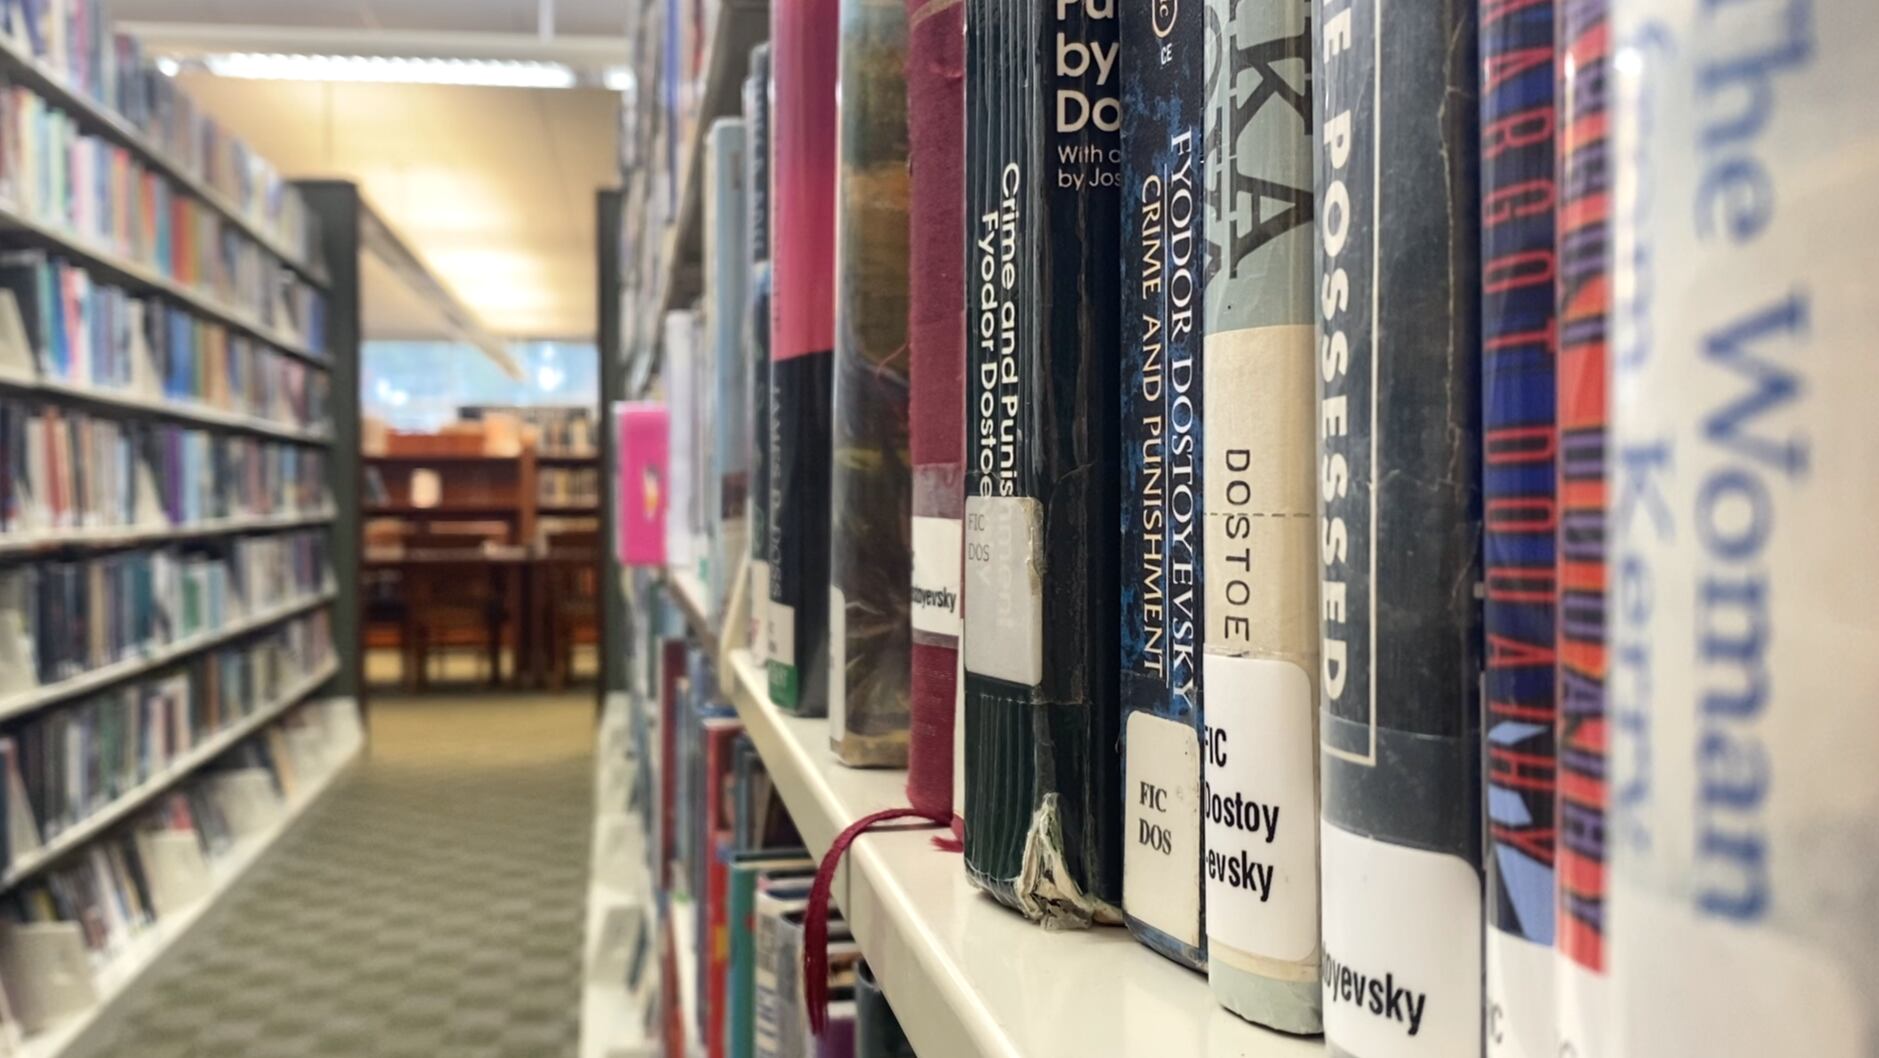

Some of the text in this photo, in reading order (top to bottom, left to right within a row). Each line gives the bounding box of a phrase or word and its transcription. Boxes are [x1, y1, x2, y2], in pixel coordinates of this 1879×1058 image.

[1057, 32, 1119, 85] by
[1057, 89, 1121, 133] Do
[1058, 145, 1103, 164] With
[1058, 171, 1121, 191] by Jos
[1001, 161, 1020, 291] Crime
[978, 210, 998, 351] Fyodor
[1000, 306, 1018, 384] and
[1141, 174, 1164, 678] CRIME AND PUNISHMENT
[1171, 126, 1194, 709] FYODOR DOSTOYEVSKY
[1321, 108, 1352, 700] POSSESSED
[968, 512, 985, 532] FIC
[968, 543, 990, 561] DOS
[1225, 449, 1251, 642] DOSTOE
[1693, 284, 1815, 924] Woman
[1139, 781, 1168, 814] FIC
[1138, 817, 1172, 856] DOS
